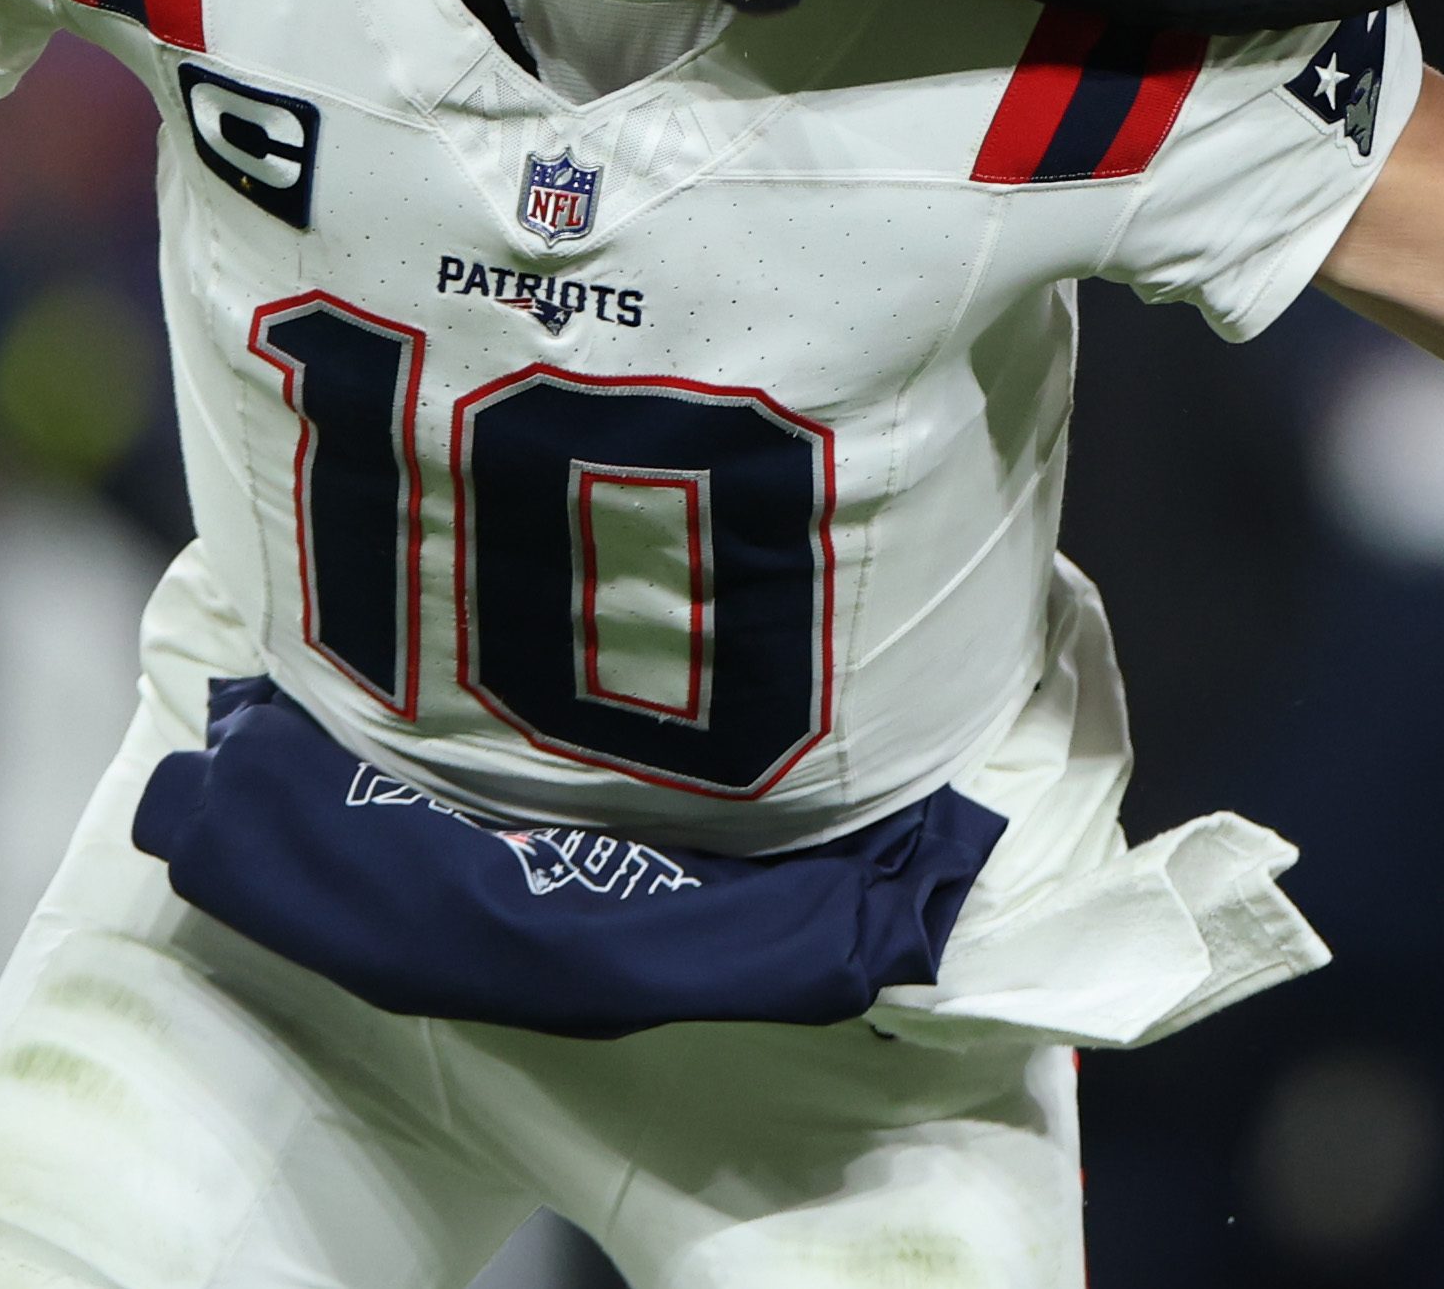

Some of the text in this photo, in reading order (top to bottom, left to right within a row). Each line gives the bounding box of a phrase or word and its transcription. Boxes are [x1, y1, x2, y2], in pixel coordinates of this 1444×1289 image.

[190, 82, 305, 189] C
[528, 188, 583, 229] NFL
[437, 255, 644, 328] PATRIOTS
[248, 289, 836, 801] 10
